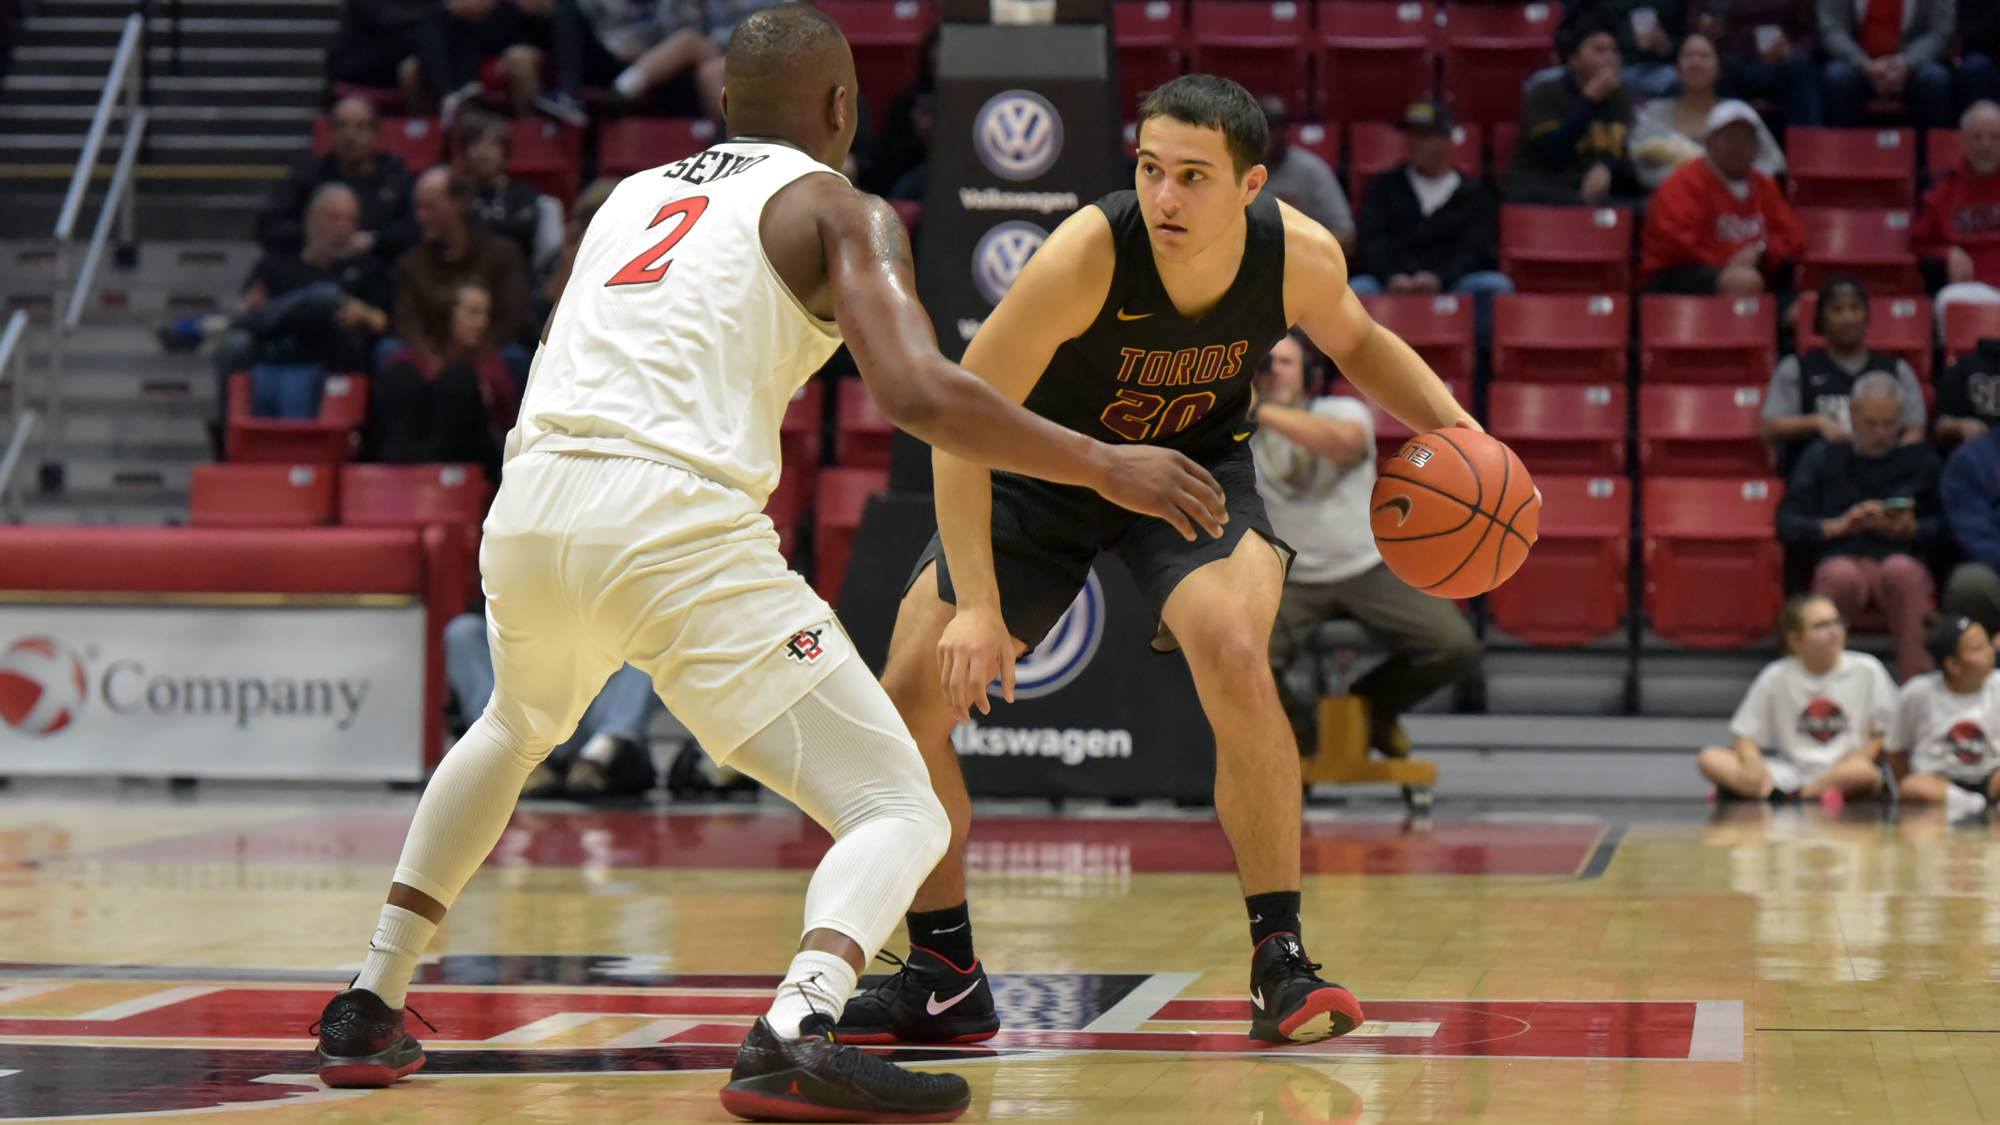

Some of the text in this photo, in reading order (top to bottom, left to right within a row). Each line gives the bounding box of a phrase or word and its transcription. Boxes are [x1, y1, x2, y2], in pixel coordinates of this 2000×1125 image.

[959, 187, 1079, 214] Volkswagen
[604, 195, 710, 288] 2
[1116, 340, 1248, 386] TOROS
[1100, 388, 1217, 441] 20
[101, 658, 370, 731] Company
[953, 719, 1133, 766] lkswagen
